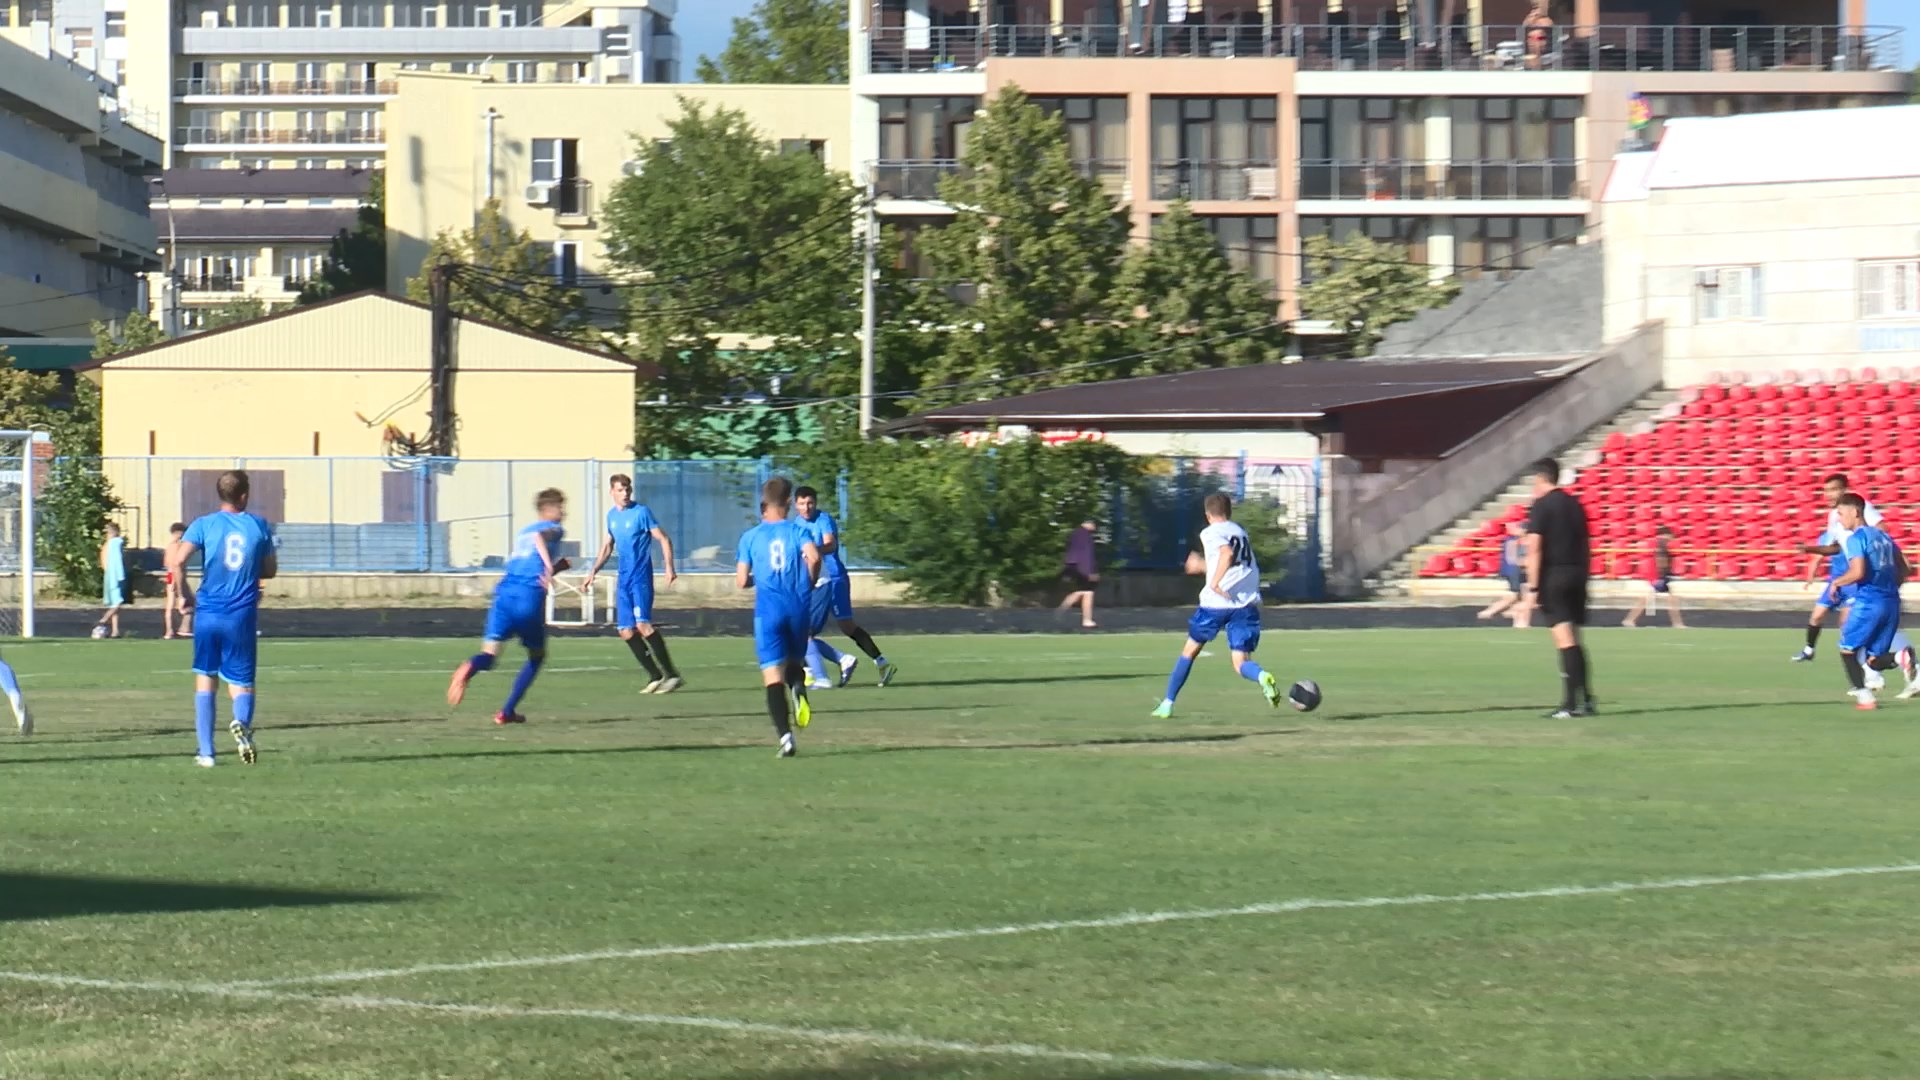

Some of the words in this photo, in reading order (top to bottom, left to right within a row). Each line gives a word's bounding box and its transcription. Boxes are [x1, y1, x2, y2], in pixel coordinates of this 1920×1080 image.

[225, 532, 245, 570] 6
[769, 539, 786, 570] 8
[1230, 535, 1252, 566] 24
